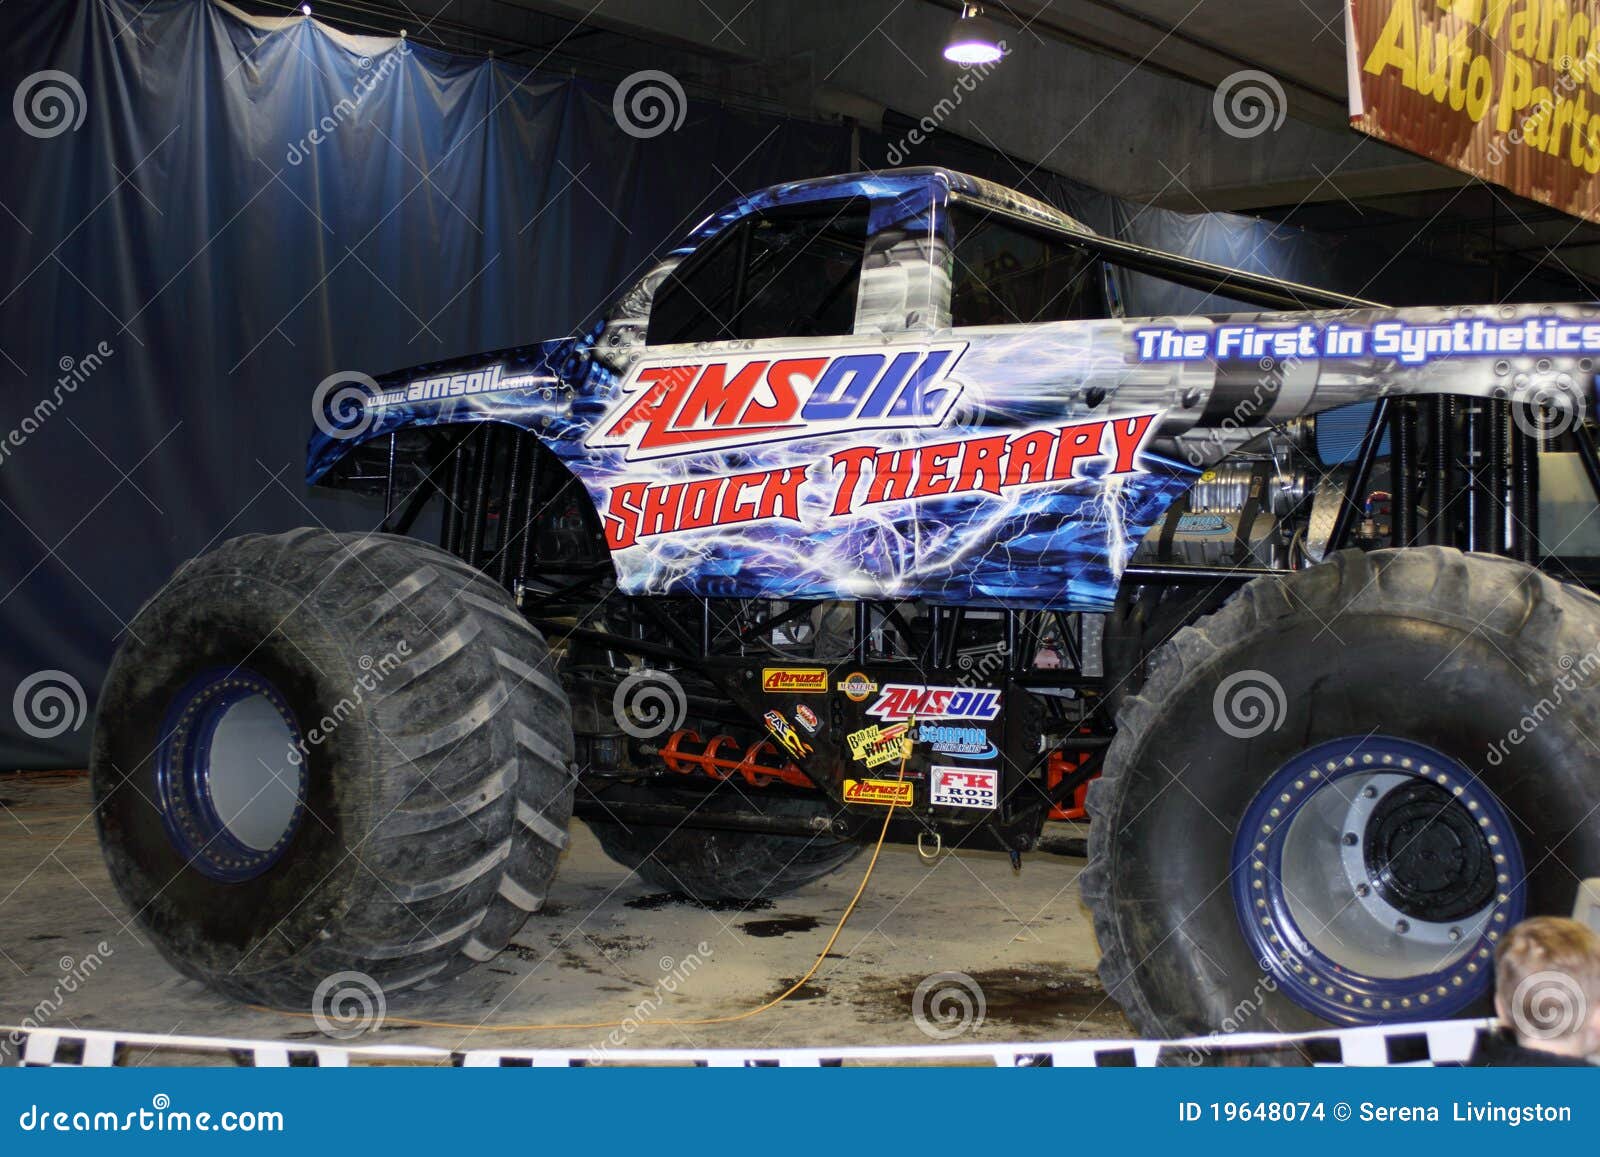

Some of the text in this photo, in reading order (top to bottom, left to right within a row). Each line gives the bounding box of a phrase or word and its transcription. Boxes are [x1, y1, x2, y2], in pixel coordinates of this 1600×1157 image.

[1364, 0, 1600, 174] Auto Parts
[1137, 320, 1600, 362] The First in Synthetics
[604, 349, 954, 451] AMSOIL
[604, 413, 1155, 552] SHOCK THERAPY
[874, 687, 1000, 719] AMSOIL
[918, 725, 987, 745] SCORPION
[940, 772, 993, 789] FK
[949, 788, 993, 798] ROD
[934, 795, 993, 807] ENDS
